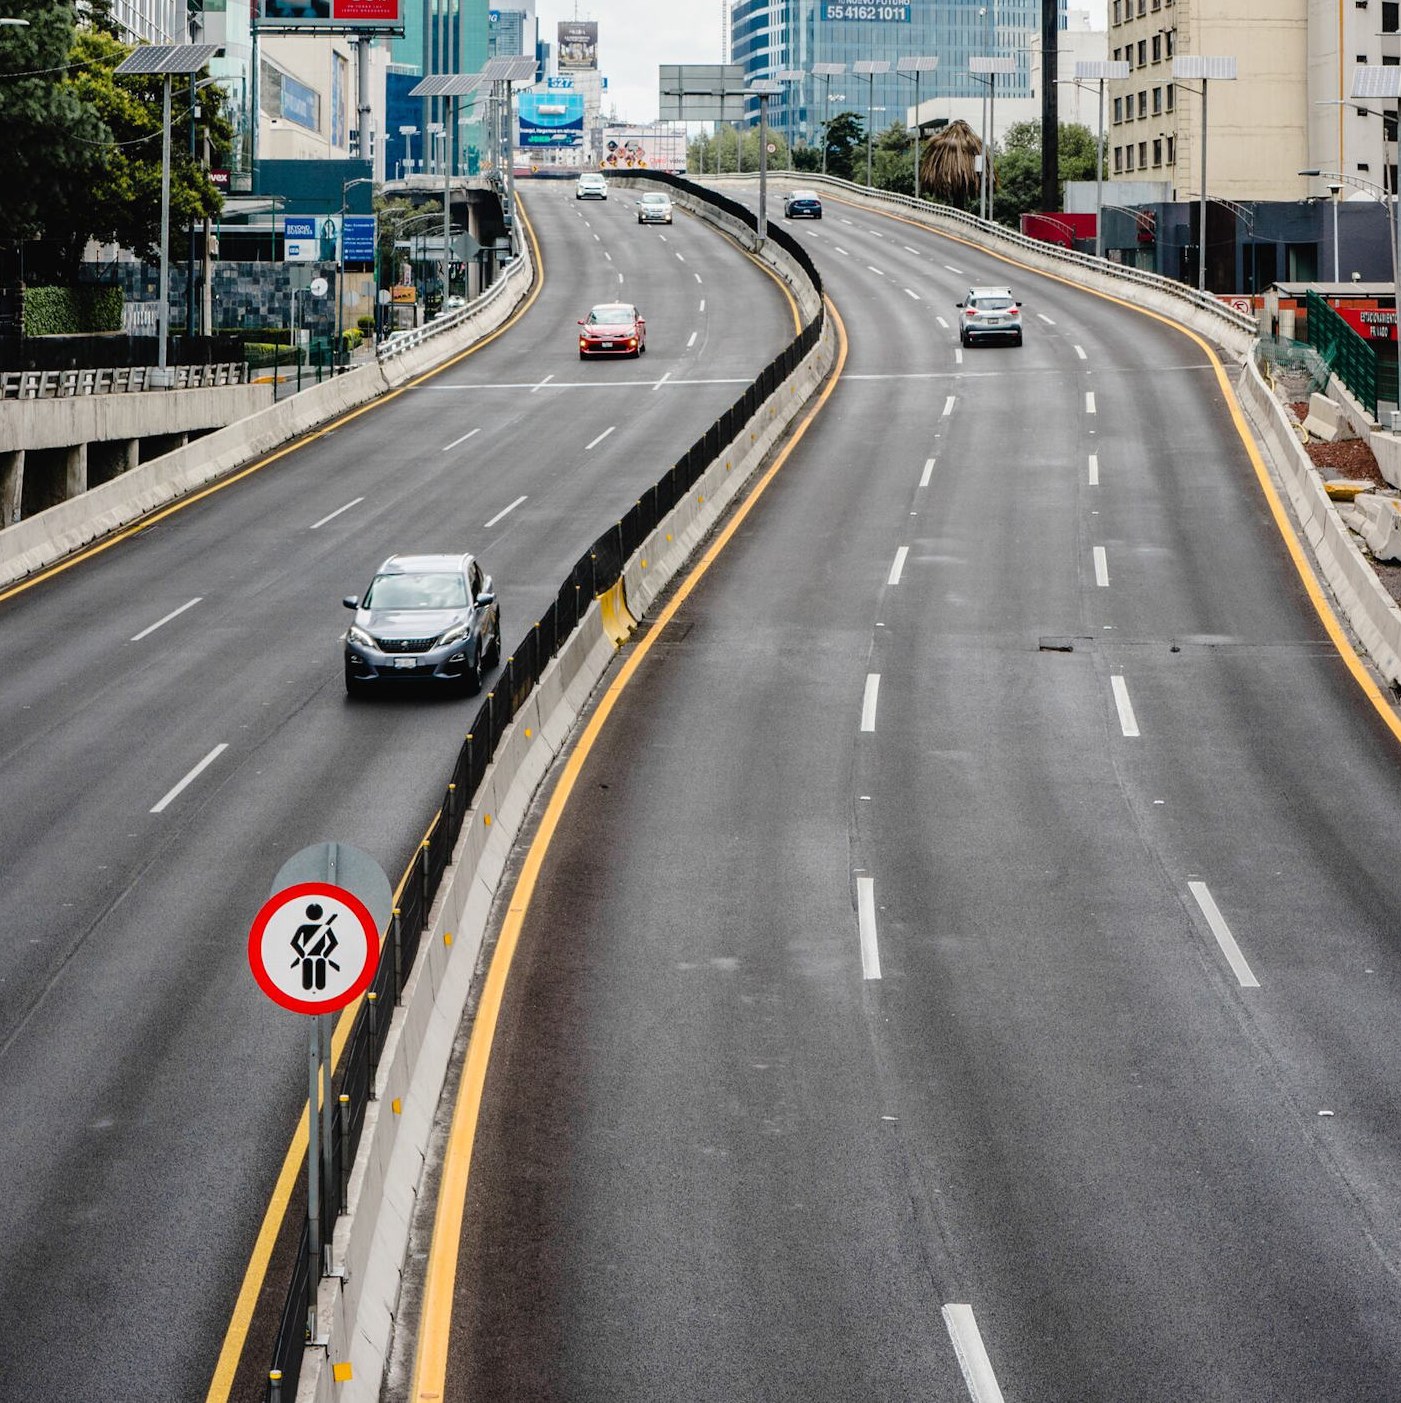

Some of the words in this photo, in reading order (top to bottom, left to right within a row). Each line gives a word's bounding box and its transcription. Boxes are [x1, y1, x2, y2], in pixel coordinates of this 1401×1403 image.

[827, 6, 844, 19] 55
[845, 6, 876, 20] 4162
[878, 7, 905, 20] 1011
